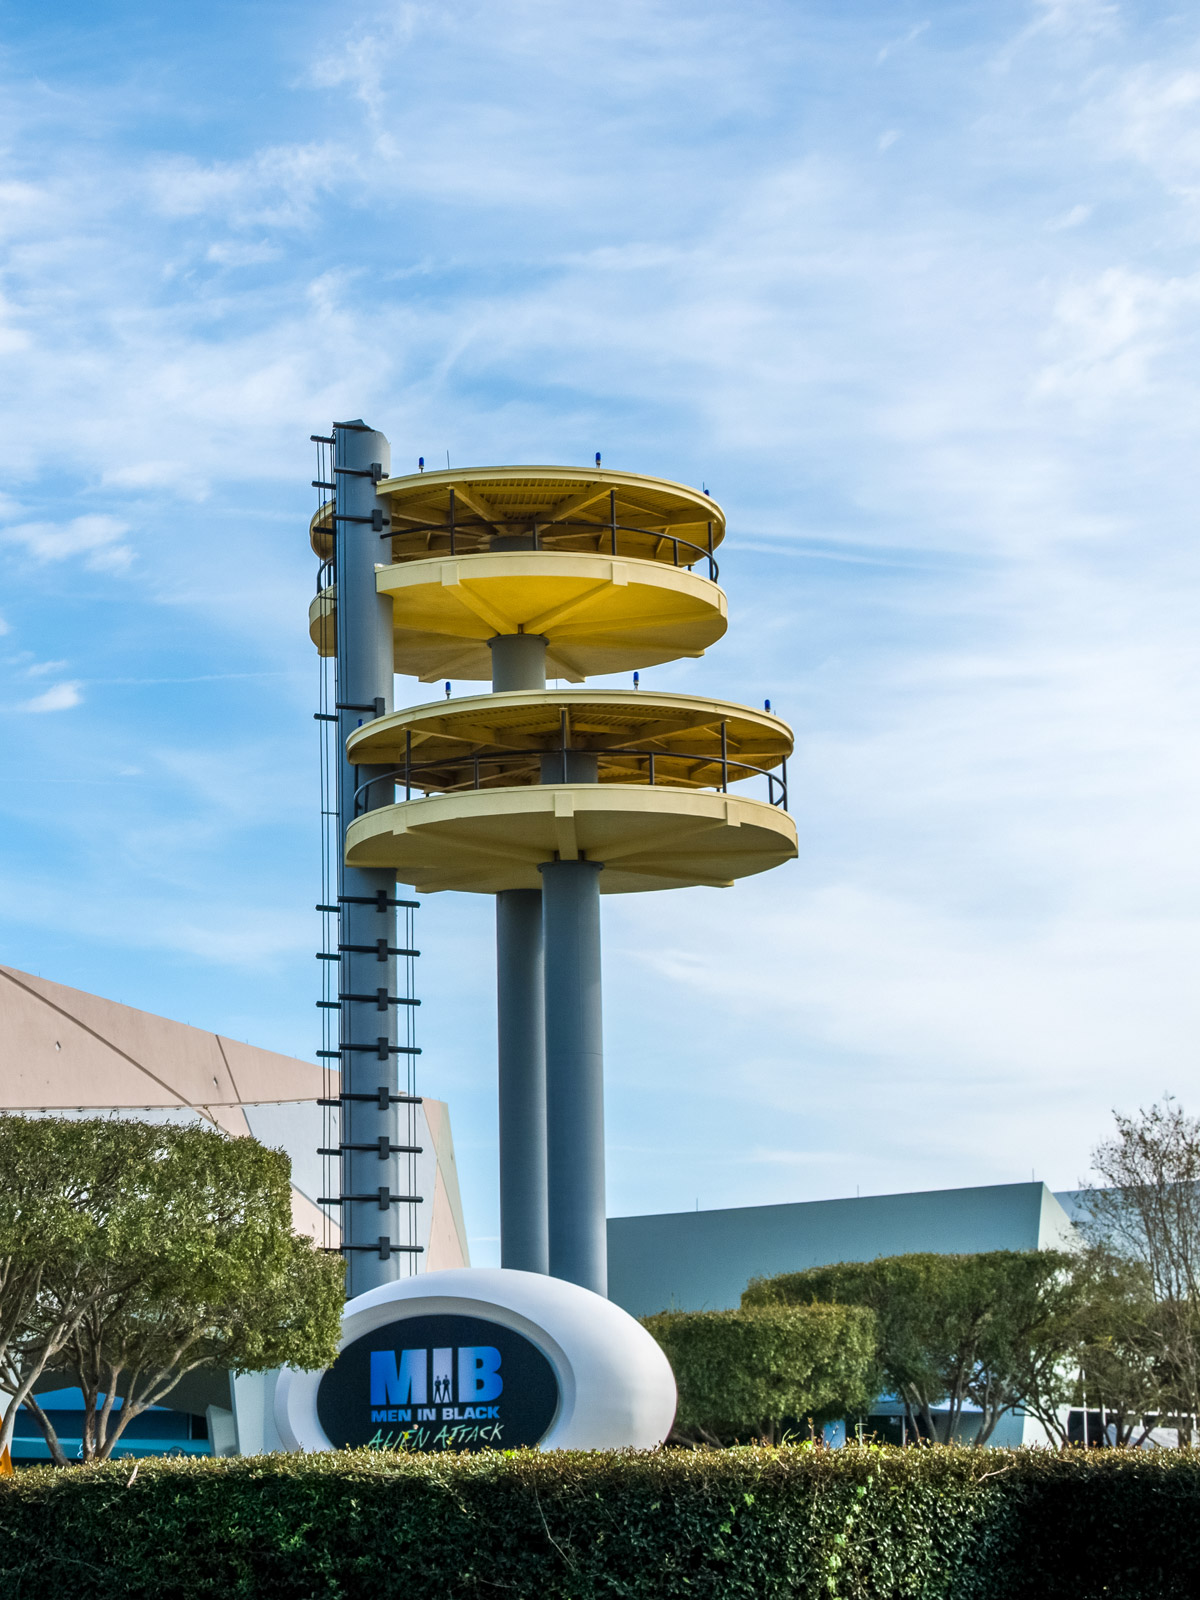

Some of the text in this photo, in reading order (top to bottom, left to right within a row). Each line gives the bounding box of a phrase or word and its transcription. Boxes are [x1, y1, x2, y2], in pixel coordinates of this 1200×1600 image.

[370, 1346, 503, 1406] MIB
[371, 1406, 500, 1423] MEN IN BLACK
[368, 1422, 504, 1450] ALIEN ATTACK
